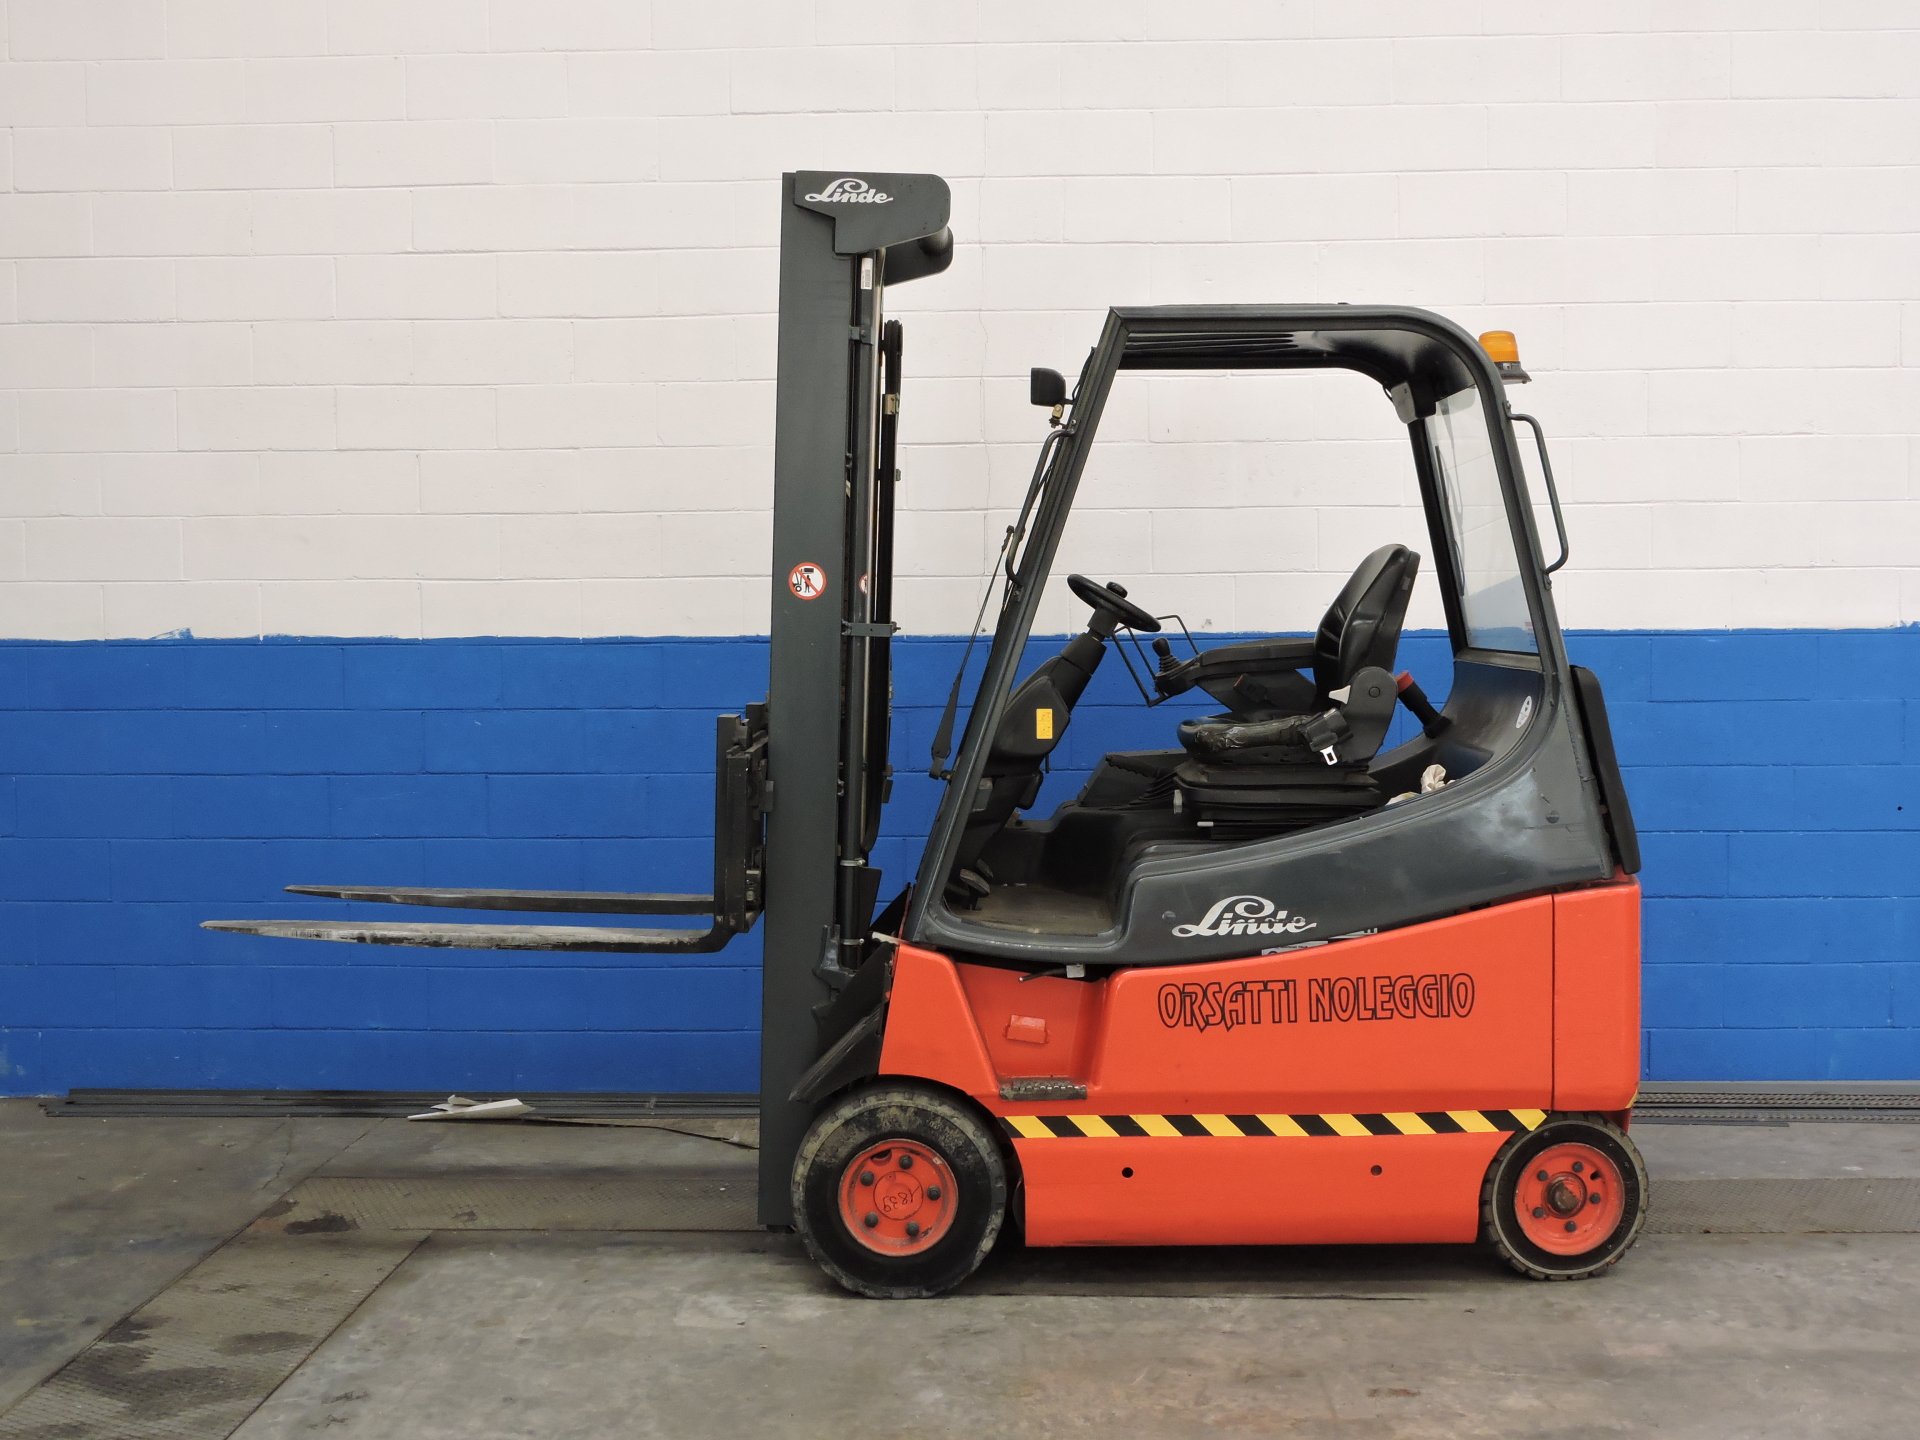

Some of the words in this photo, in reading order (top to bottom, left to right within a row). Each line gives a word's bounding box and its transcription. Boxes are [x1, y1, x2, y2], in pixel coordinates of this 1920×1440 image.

[804, 178, 893, 203] Linde
[1157, 979, 1298, 1032] ORSATTI
[1308, 973, 1475, 1023] NOLEGGIO
